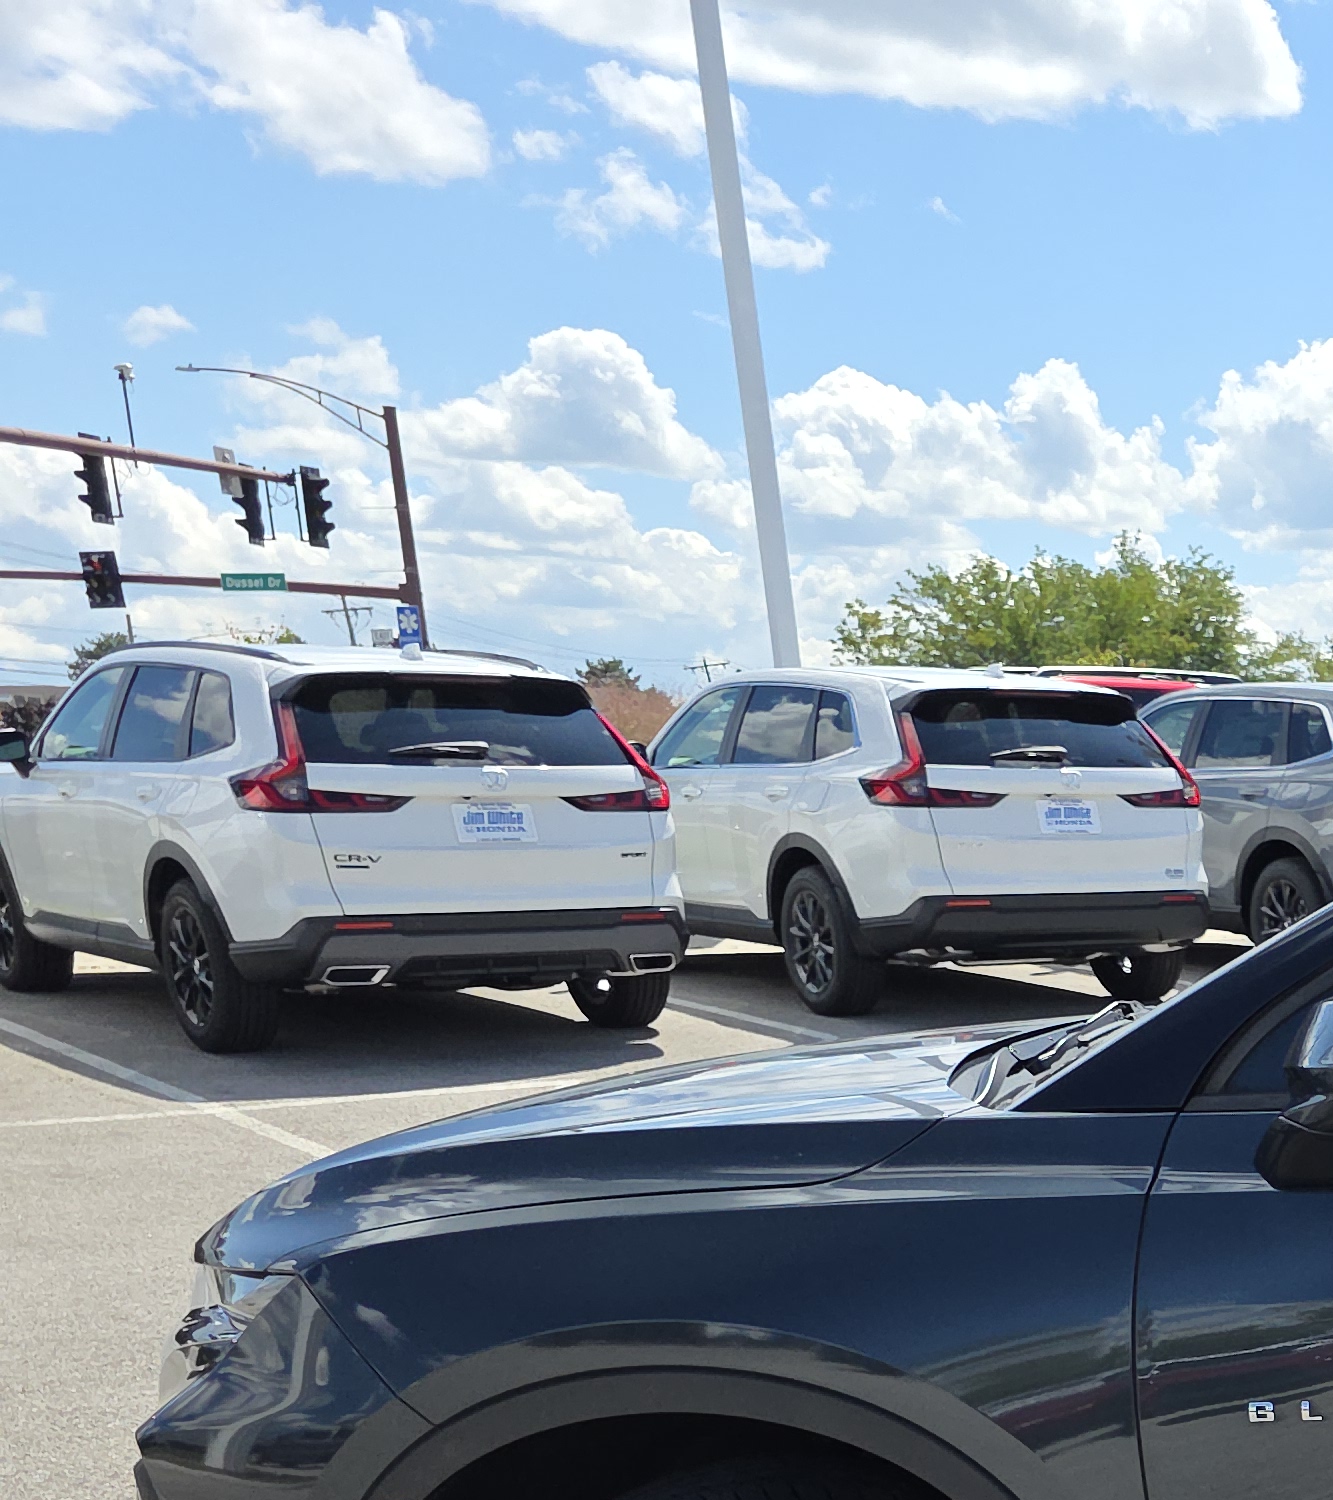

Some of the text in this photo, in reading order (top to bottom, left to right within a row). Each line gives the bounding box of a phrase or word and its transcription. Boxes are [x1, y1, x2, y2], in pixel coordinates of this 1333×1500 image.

[226, 577, 281, 588] Dussel Dr
[463, 811, 484, 825] Jim
